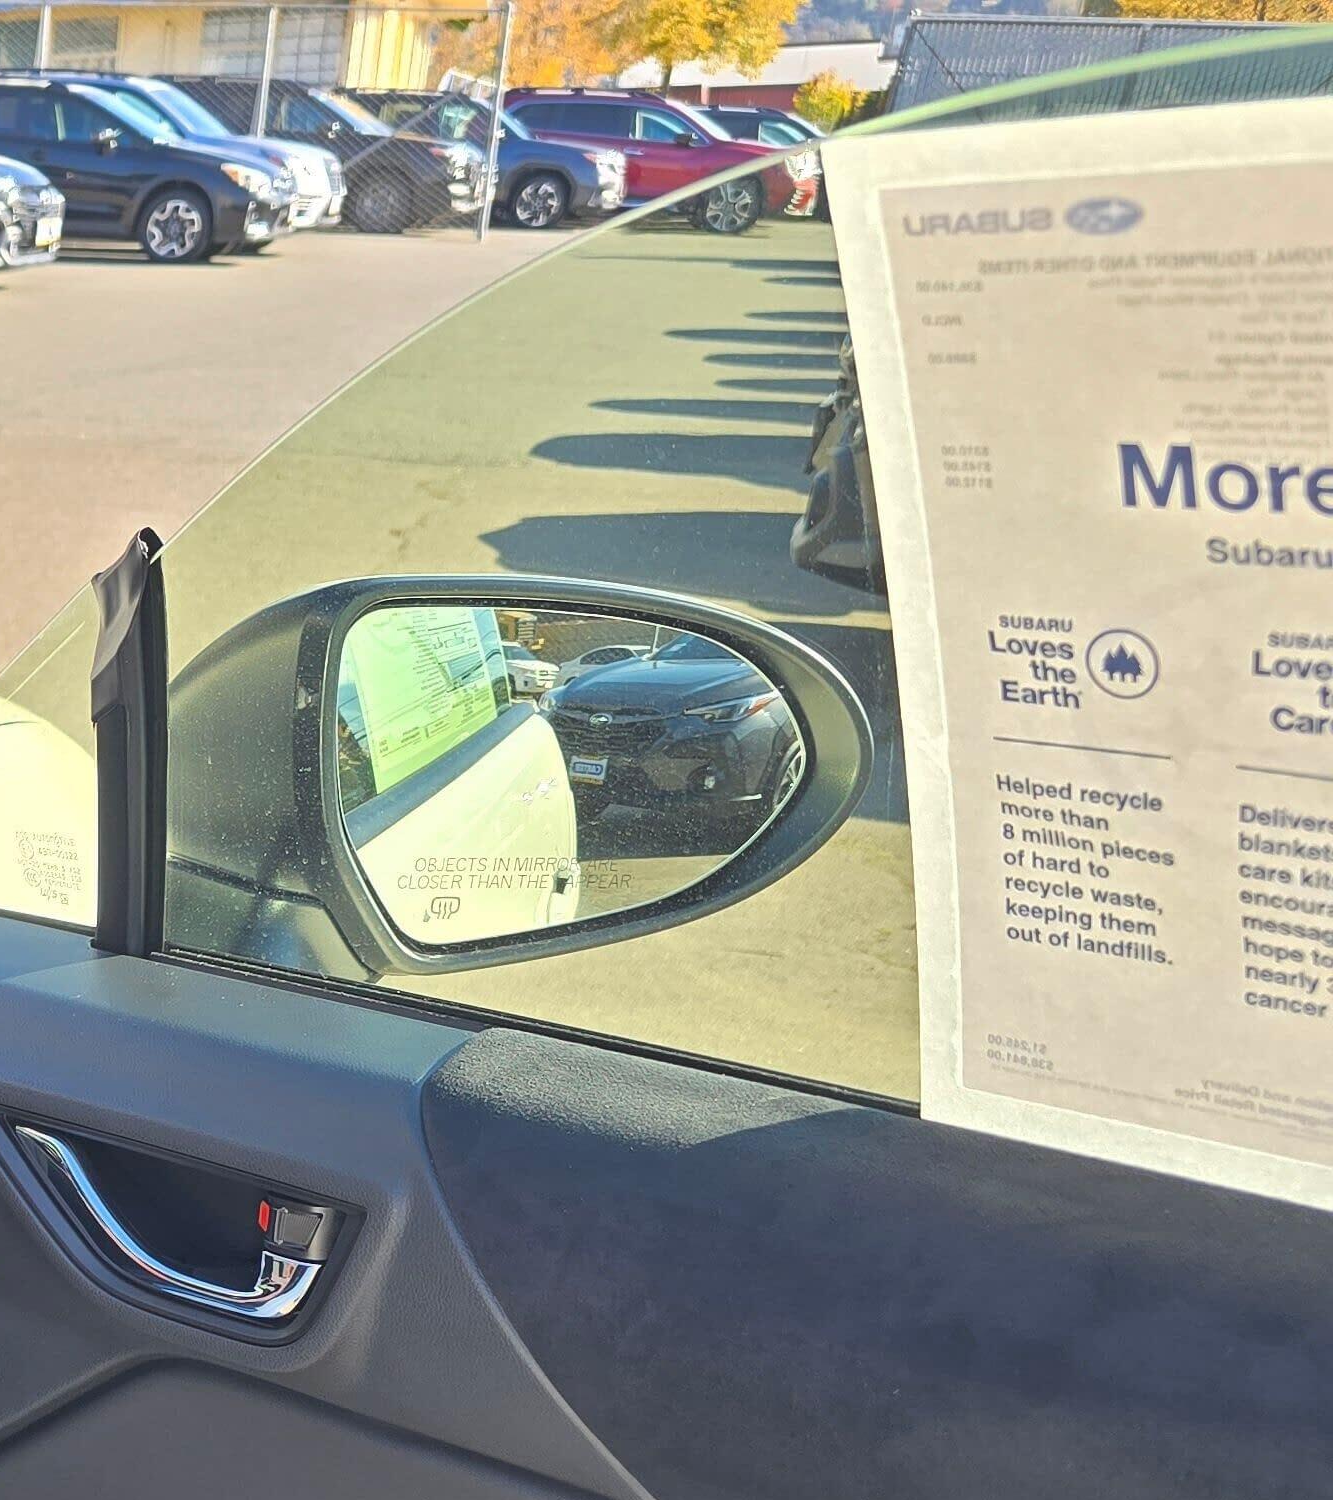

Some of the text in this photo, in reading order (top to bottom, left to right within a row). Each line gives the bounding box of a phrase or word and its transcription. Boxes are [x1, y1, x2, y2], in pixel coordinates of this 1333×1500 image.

[1119, 443, 1333, 515] More
[1206, 538, 1333, 568] Subaru
[998, 614, 1073, 633] SUBARU
[987, 630, 1074, 660] Loves
[1029, 660, 1077, 684] the
[1000, 679, 1081, 709] Earth
[1270, 706, 1333, 735] Car
[996, 774, 1163, 812] Helped recycle
[1001, 801, 1110, 831] more than
[1002, 823, 1175, 867] 8 million pieces
[1238, 832, 1333, 862] blanket
[414, 857, 619, 872] OBJECTS IN MIRROR ARE
[1003, 849, 1110, 878] of hard to
[1238, 864, 1333, 890] care kit
[397, 874, 632, 889] CLOSER THAN THEY APPEAR
[1005, 876, 1164, 915] recycle waste,
[1005, 897, 1157, 937] keeping them
[1006, 925, 1174, 965] out of landfills.
[1243, 936, 1333, 968] hope to
[1244, 965, 1319, 994] nearly
[1244, 992, 1328, 1017] cancer
